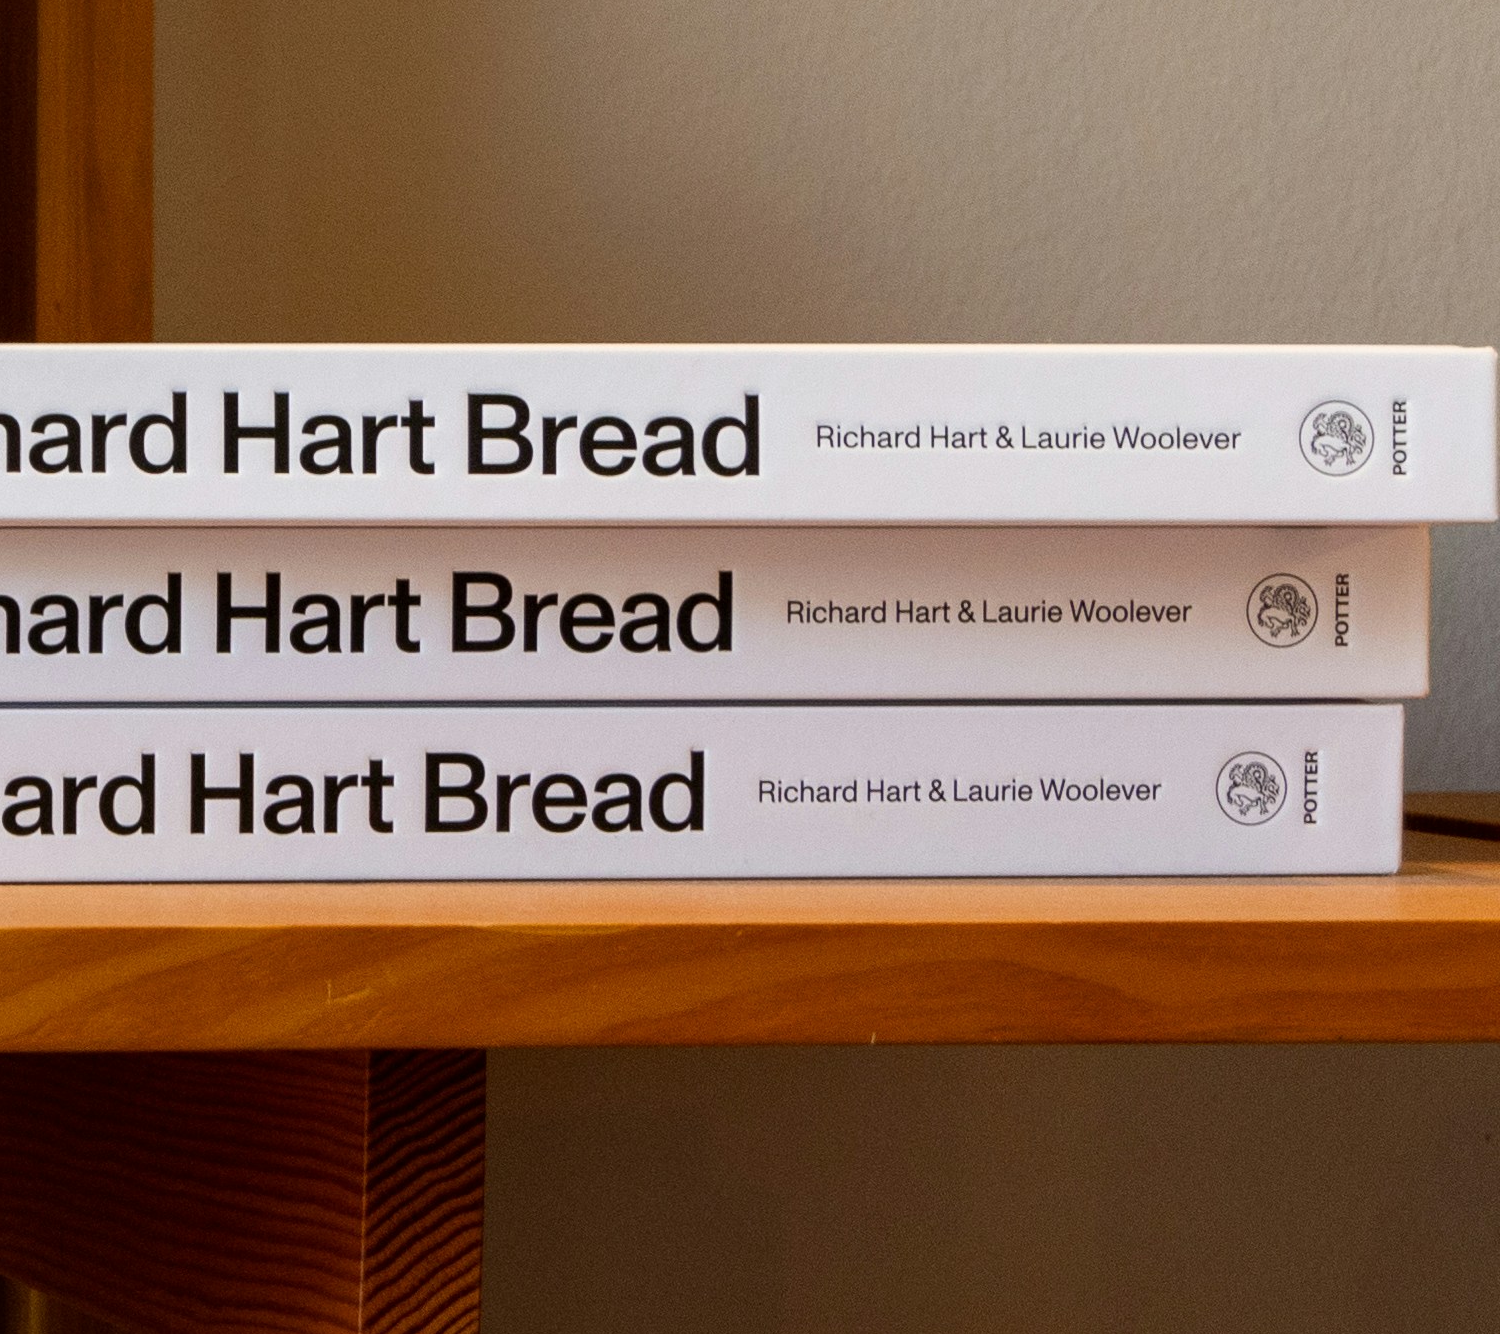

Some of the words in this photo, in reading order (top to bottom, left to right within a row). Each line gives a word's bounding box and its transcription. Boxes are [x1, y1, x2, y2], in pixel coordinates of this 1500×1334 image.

[223, 391, 436, 475] Hart
[467, 393, 760, 477] Bread
[816, 424, 921, 449] Richard
[930, 425, 988, 449] Hart
[995, 425, 1014, 449] &
[1021, 425, 1106, 450] Laurie
[1112, 426, 1242, 450] Woolever
[1392, 400, 1408, 476] POTTER
[216, 571, 422, 654] Hart
[451, 570, 733, 654] Bread
[787, 599, 887, 624] Richard
[895, 600, 951, 624] Hart
[957, 599, 976, 624] &
[982, 599, 1063, 624] Laurie
[1069, 599, 1193, 623] Woolever
[1334, 572, 1350, 647] POTTER
[190, 753, 395, 835] Hart
[424, 750, 705, 833] Bread
[758, 779, 858, 804] Richard
[867, 779, 921, 803] Hart
[927, 778, 947, 803] &
[953, 778, 1033, 803] Laurie
[1039, 778, 1162, 802] Woolever
[1303, 750, 1319, 825] POTTER
